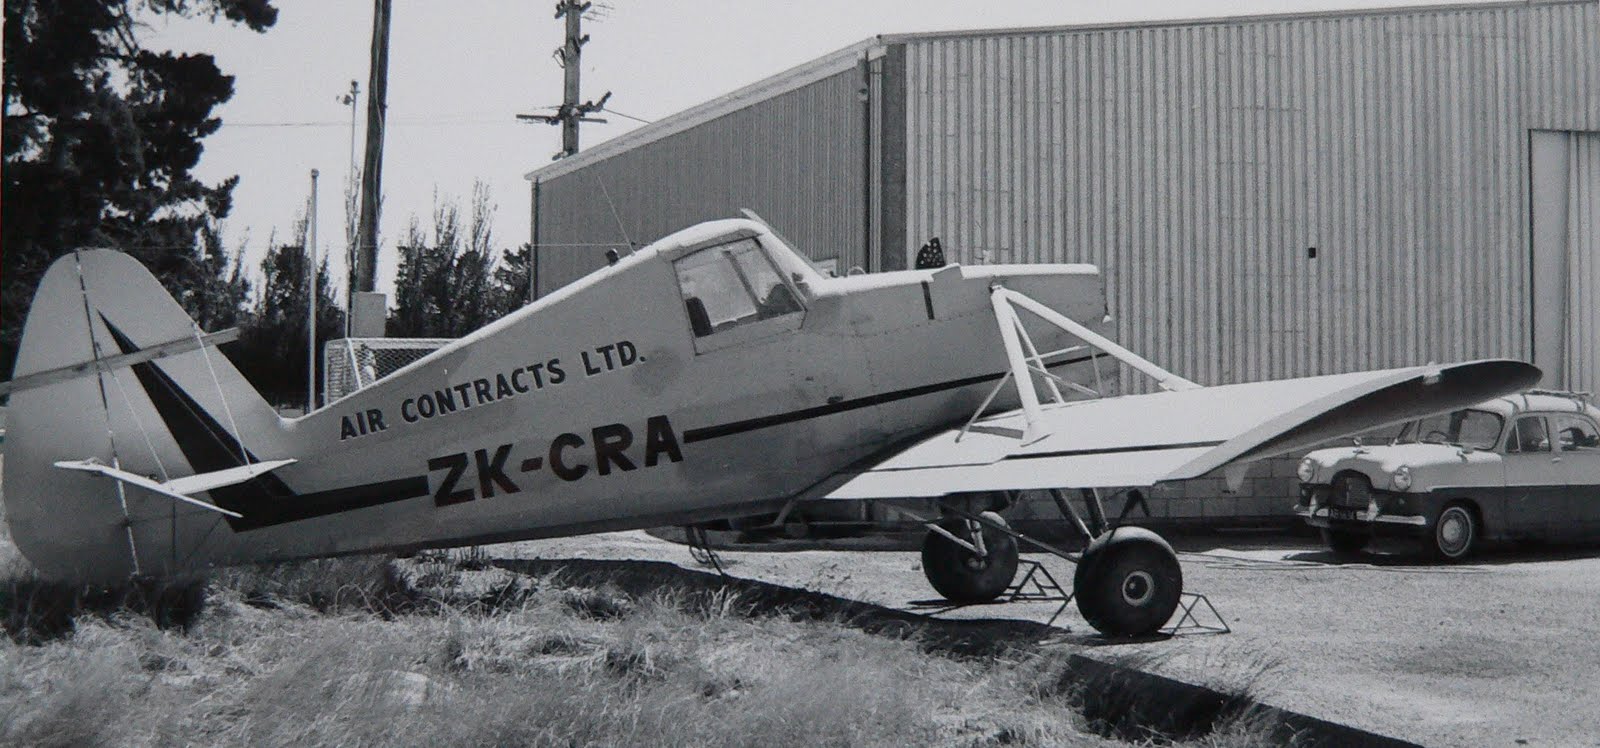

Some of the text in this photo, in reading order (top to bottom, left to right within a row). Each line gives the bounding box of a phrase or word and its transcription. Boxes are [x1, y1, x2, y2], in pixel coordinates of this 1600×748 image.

[340, 340, 647, 441] AIR CONTRACTS LTD.
[427, 415, 684, 508] ZK-CRA
